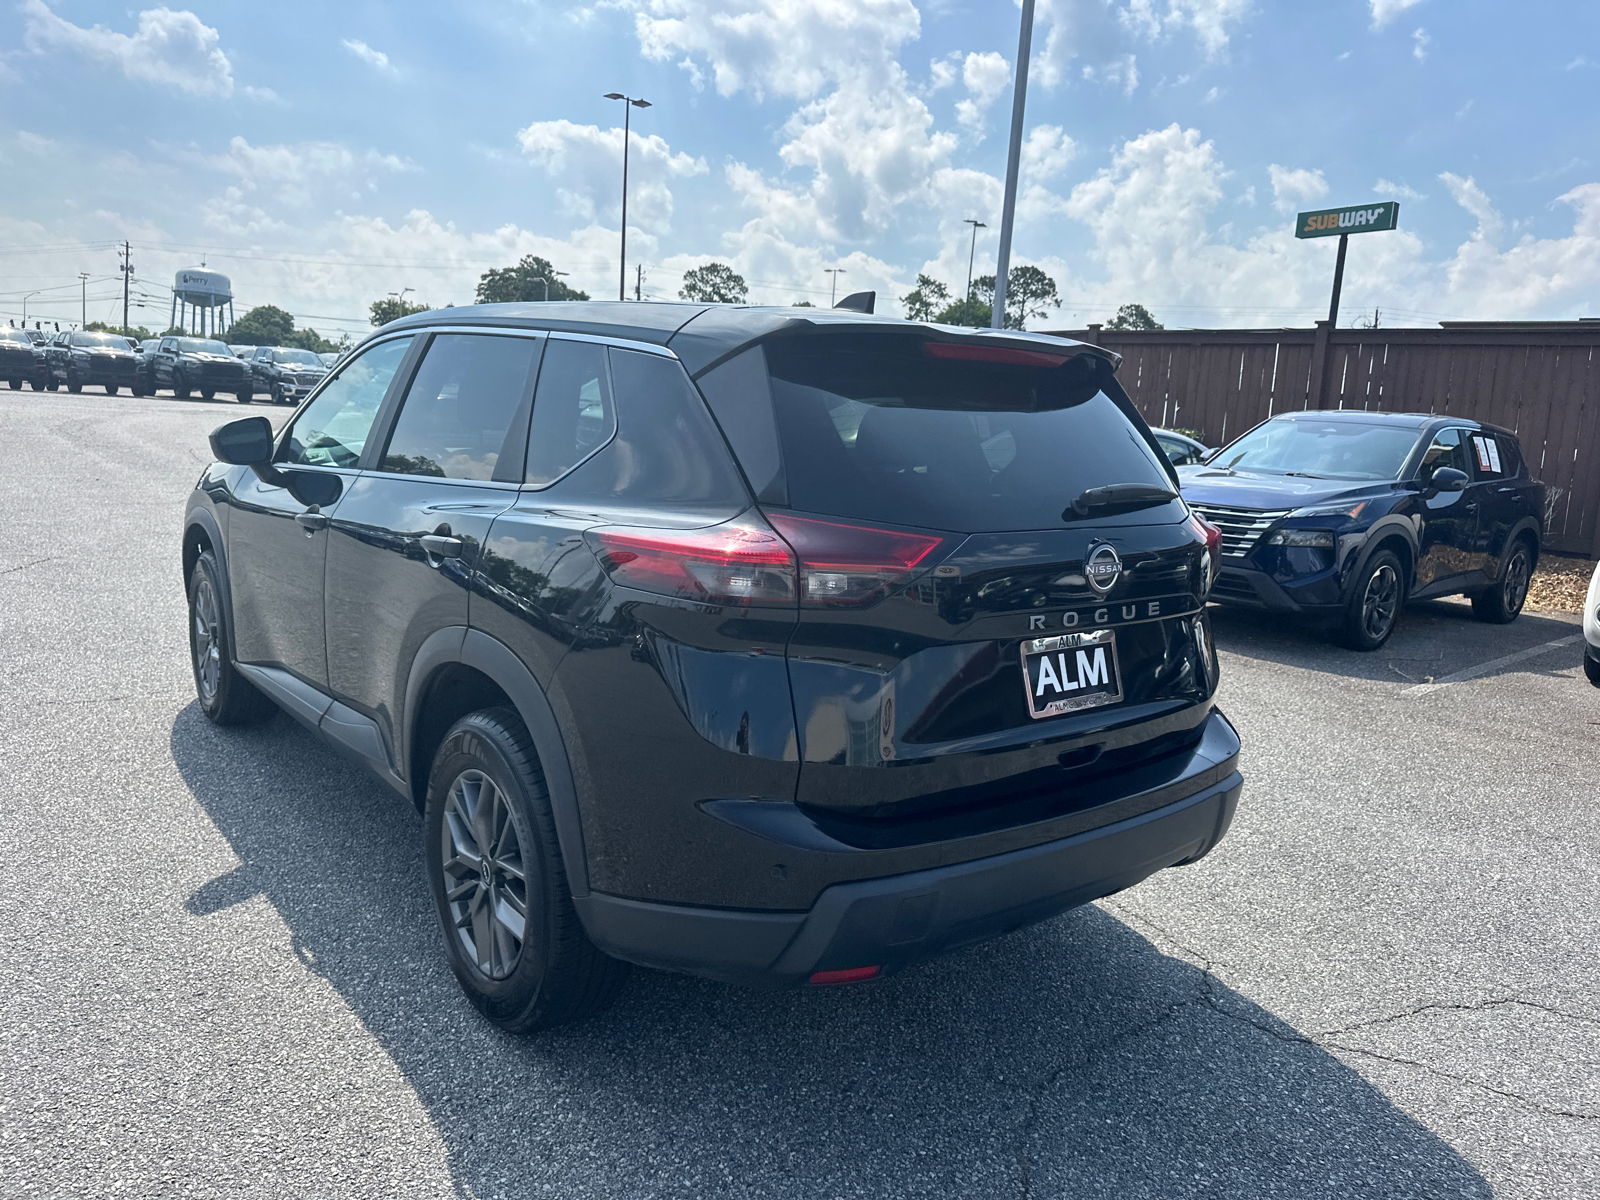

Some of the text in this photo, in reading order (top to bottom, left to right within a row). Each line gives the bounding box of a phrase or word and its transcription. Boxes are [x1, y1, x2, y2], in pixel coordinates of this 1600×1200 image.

[1303, 207, 1385, 232] SUBWAY
[188, 275, 208, 285] Perry
[1086, 564, 1122, 574] NISSAN
[1029, 601, 1160, 630] ROGUE
[1057, 634, 1081, 648] ALM
[1036, 647, 1109, 696] ALM
